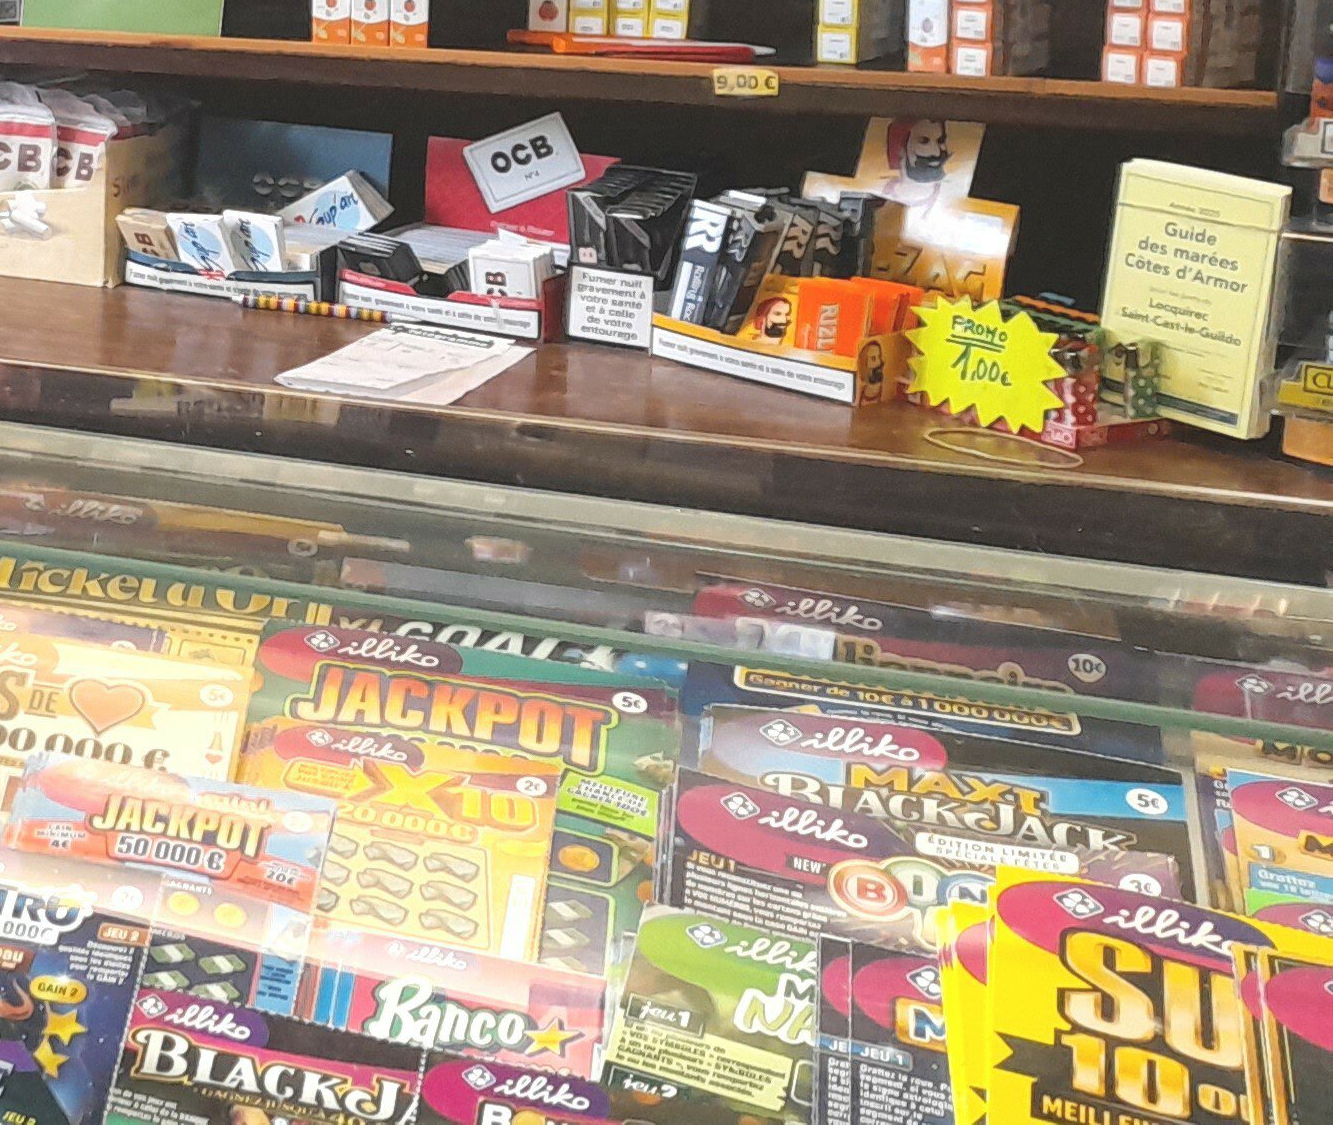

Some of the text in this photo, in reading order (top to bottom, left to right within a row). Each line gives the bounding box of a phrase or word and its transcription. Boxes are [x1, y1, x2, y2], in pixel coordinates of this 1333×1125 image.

[764, 76, 776, 90] €
[490, 134, 554, 174] OCB
[1164, 221, 1217, 246] Guide
[1138, 236, 1239, 272] des marées
[582, 272, 642, 289] Fumer nuit
[1125, 252, 1248, 293] Côtes d'Armor
[577, 283, 636, 298] gravement
[580, 295, 608, 305] votre
[585, 305, 595, 313] et
[609, 309, 635, 319] celle
[587, 315, 633, 329] de votre
[1149, 297, 1209, 322] Locquirec
[581, 325, 638, 341] entourage
[951, 315, 1008, 343] PROMO
[775, 598, 884, 632] illiko
[338, 637, 440, 669] illiko
[27, 688, 62, 715] DE
[297, 663, 609, 768] JACKPOT
[332, 734, 409, 765] illiko
[800, 727, 920, 762] illiko
[1136, 793, 1161, 809] 5€
[90, 793, 273, 858] JACKPOT
[757, 807, 868, 850] illiko
[117, 835, 225, 870] 50 000 €
[688, 850, 726, 869] JEU
[793, 857, 823, 874] NEW
[166, 1004, 252, 1041] illiko
[367, 976, 526, 1047] Banco
[642, 1001, 678, 1023] jeu
[860, 1046, 891, 1063] JEU
[494, 1076, 591, 1113] illiko
